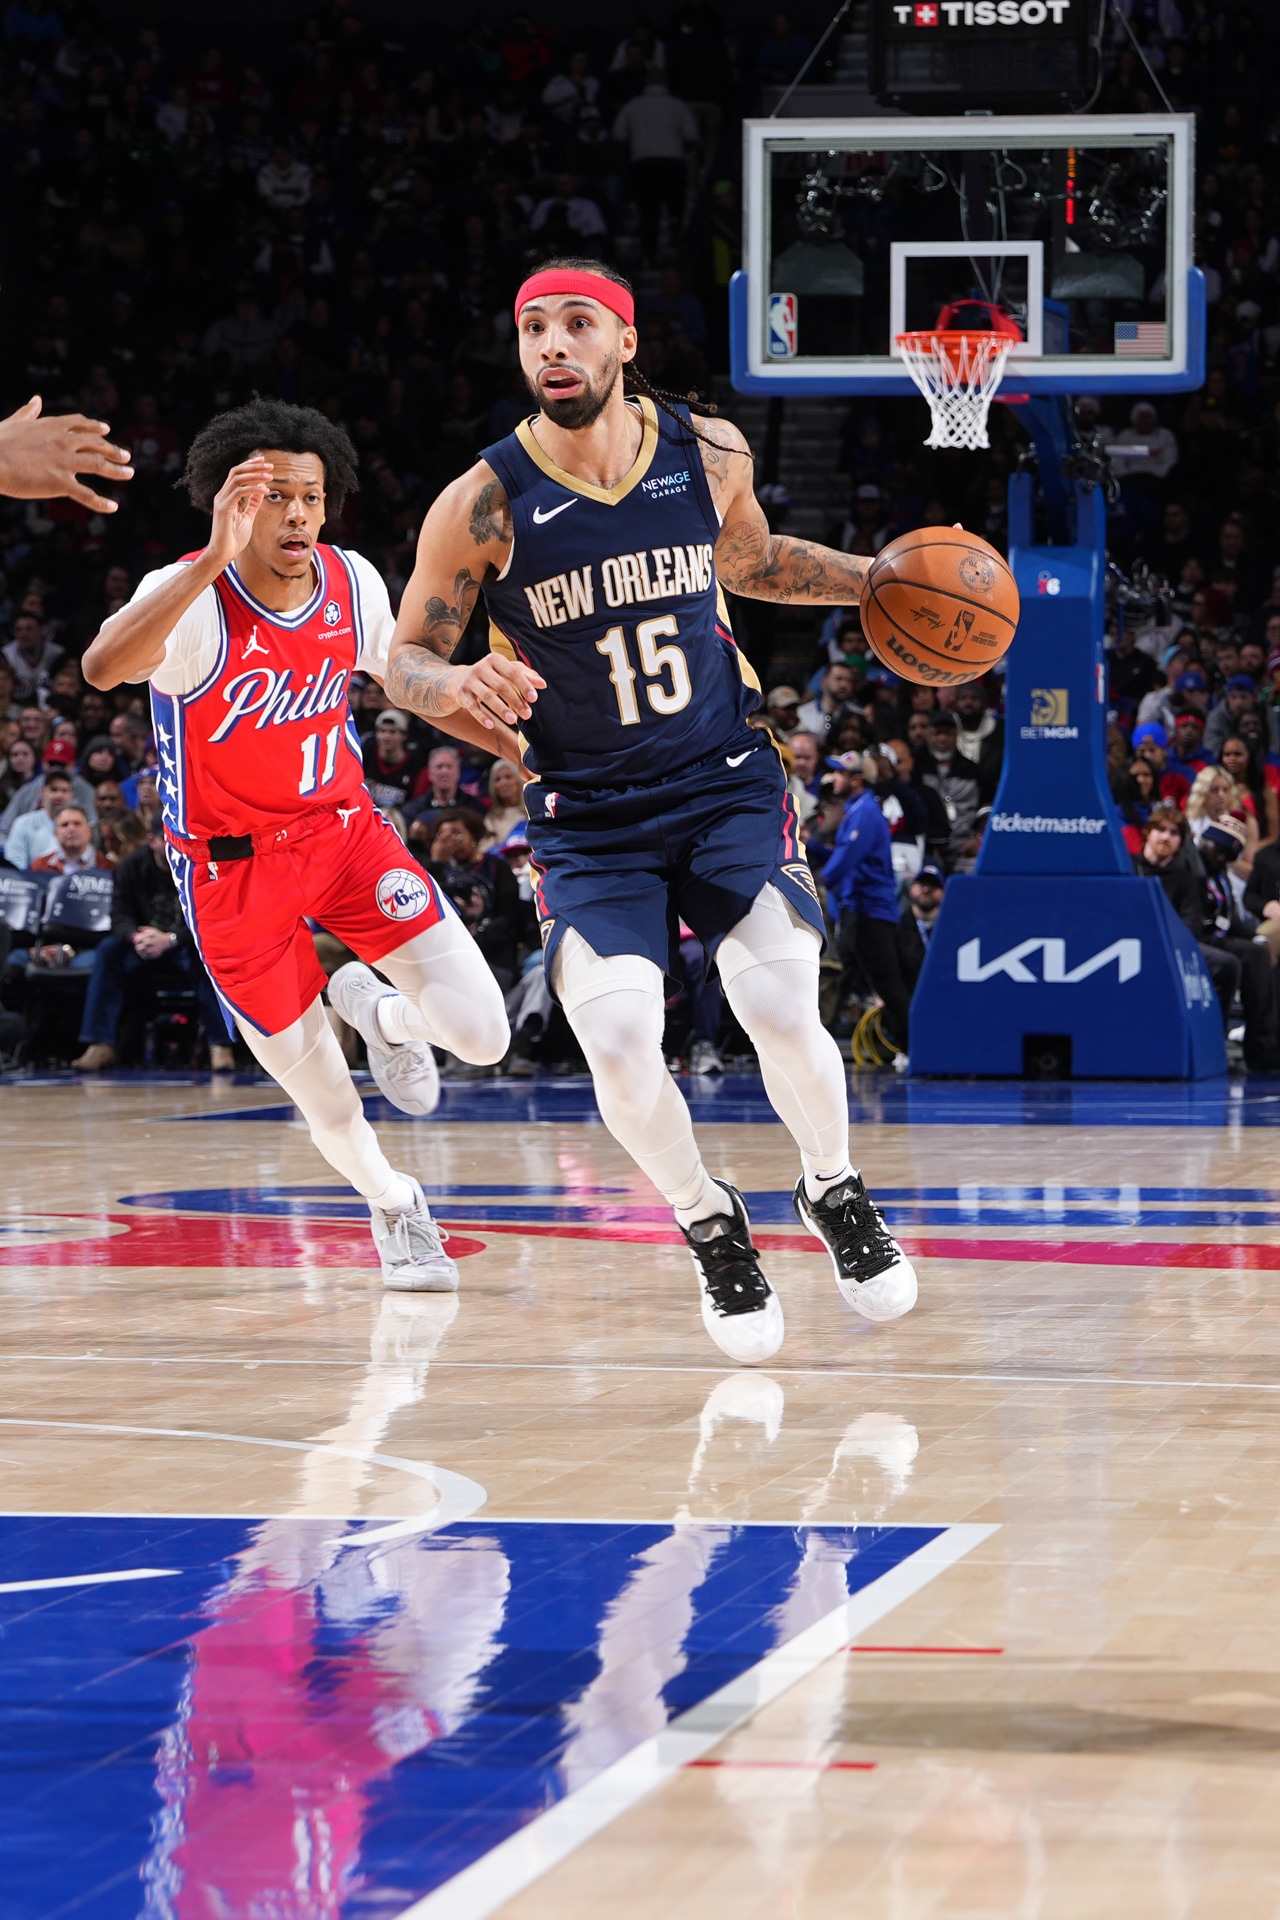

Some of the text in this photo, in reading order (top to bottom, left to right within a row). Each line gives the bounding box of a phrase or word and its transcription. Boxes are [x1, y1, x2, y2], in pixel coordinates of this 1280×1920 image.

[940, 0, 1071, 26] TISSOT
[641, 470, 691, 492] NEWAGE
[651, 484, 687, 499] GARAGE
[523, 543, 714, 629] NEW ORLEANS
[1037, 577, 1061, 596] 76
[317, 626, 352, 640] crypto.com
[595, 614, 693, 726] 15
[886, 634, 979, 685] Wilson
[208, 657, 349, 744] Phila
[1020, 726, 1079, 740] BETMGM
[298, 724, 341, 798] 11
[991, 812, 1107, 834] ticketmaster
[382, 888, 426, 915] 76ers
